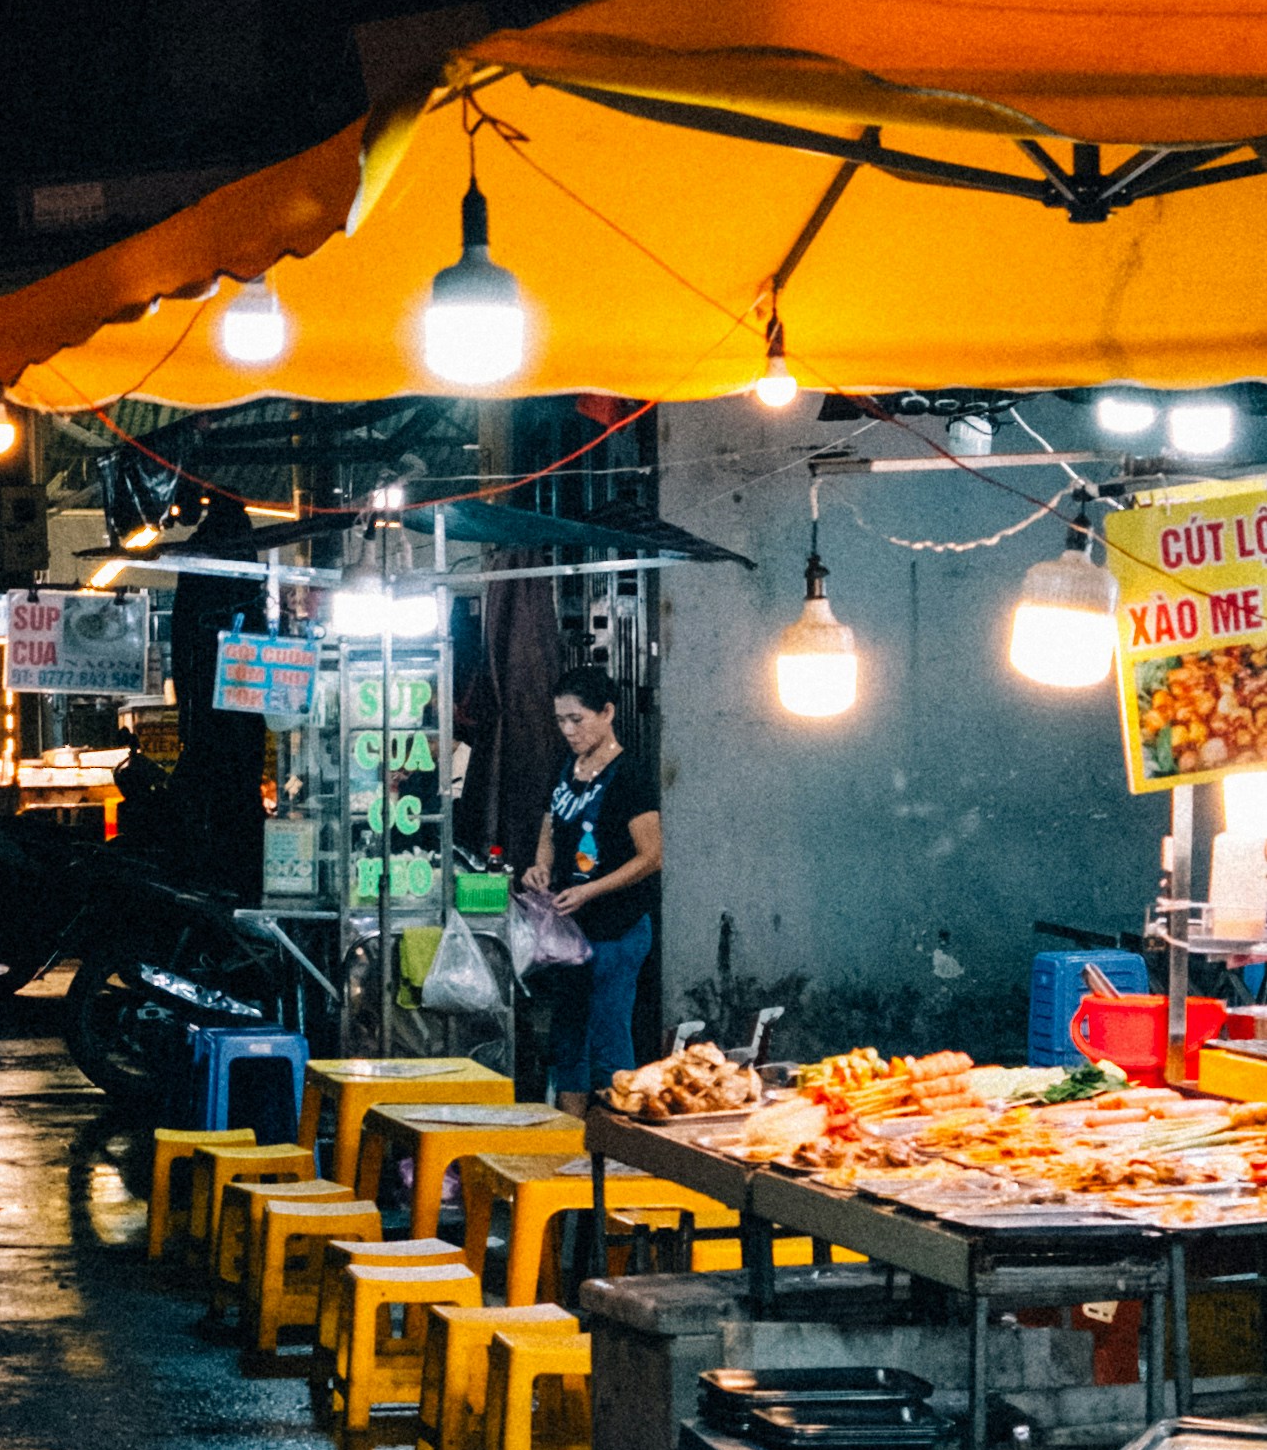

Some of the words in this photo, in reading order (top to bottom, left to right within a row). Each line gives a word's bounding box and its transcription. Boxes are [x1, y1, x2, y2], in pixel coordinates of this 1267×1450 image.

[1160, 517, 1224, 569] CÚT
[13, 605, 60, 631] SUP
[1128, 594, 1199, 646] XÀO
[1209, 589, 1262, 635] ME
[12, 641, 58, 666] CUA
